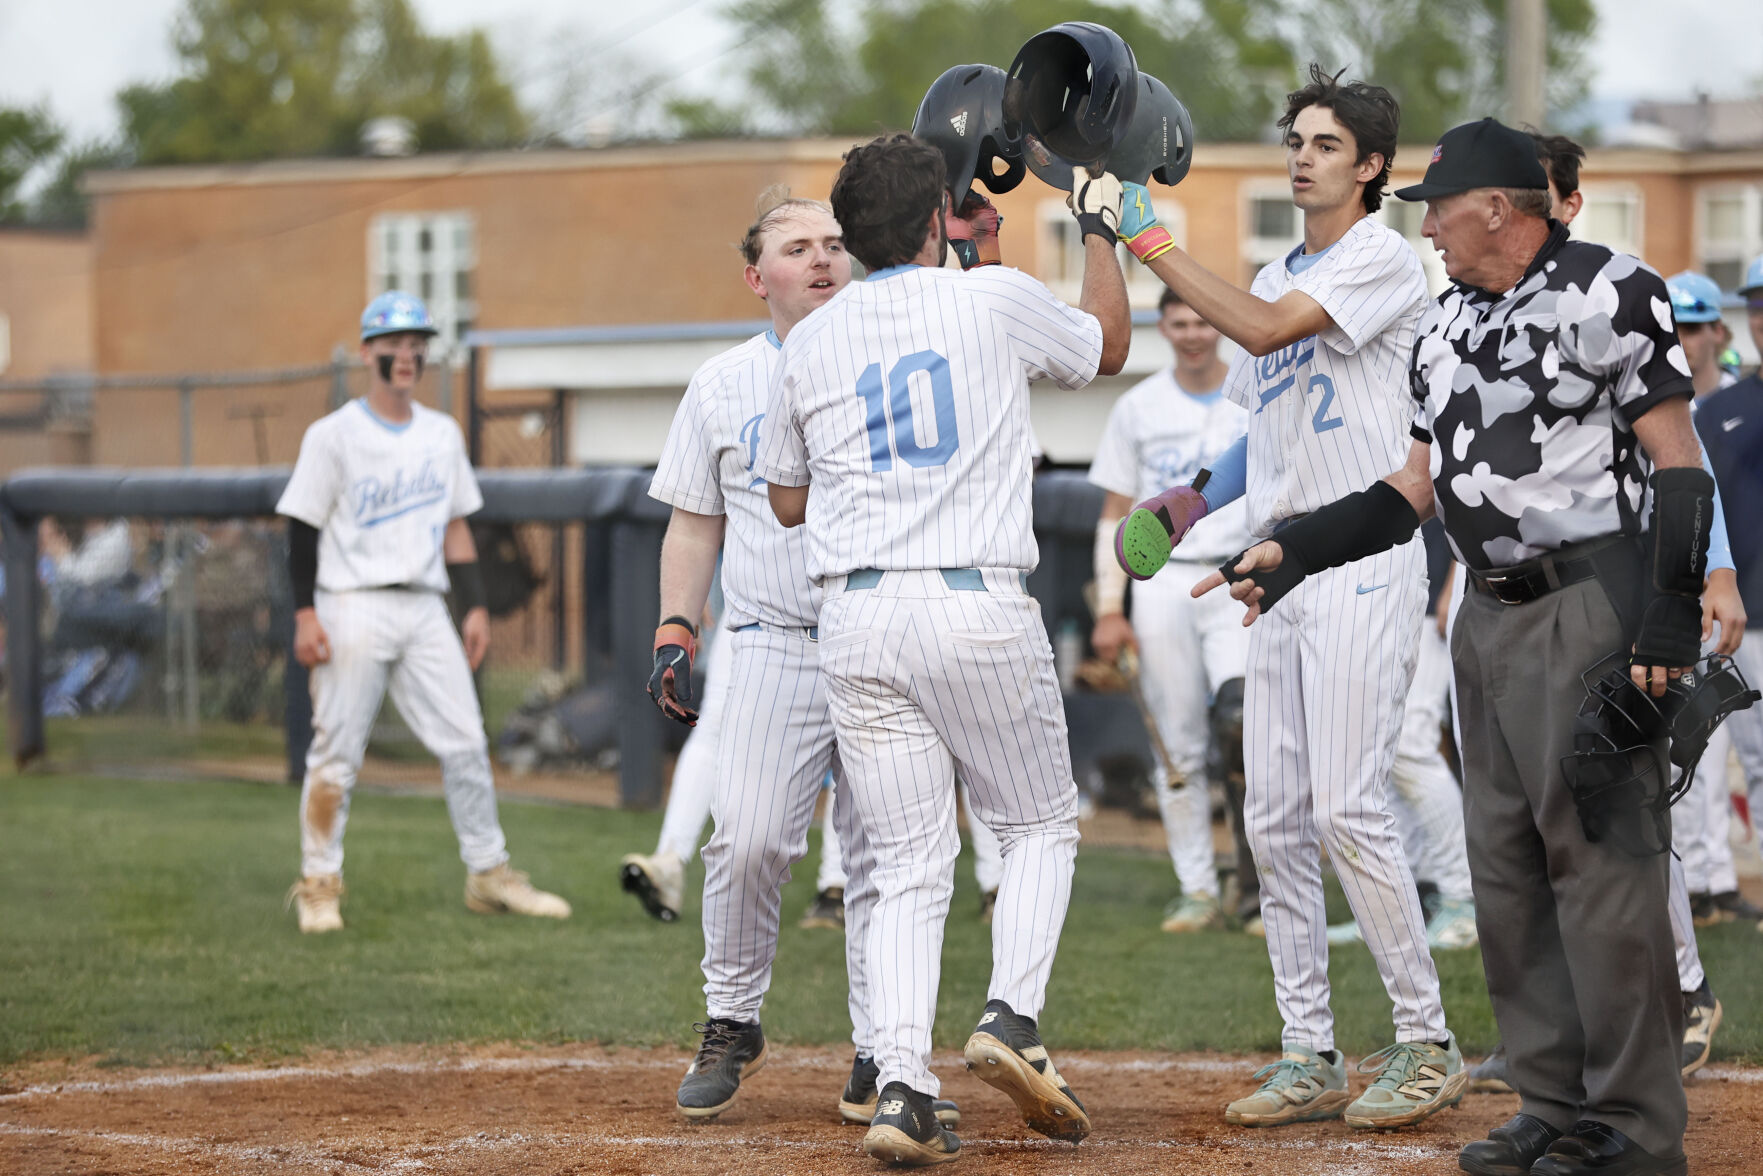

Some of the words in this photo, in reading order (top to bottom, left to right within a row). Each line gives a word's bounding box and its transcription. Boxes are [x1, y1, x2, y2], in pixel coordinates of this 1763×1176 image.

[959, 111, 968, 137] adidas
[856, 349, 960, 474] 10
[1307, 373, 1345, 435] 2
[1690, 497, 1702, 573] CENTURY
